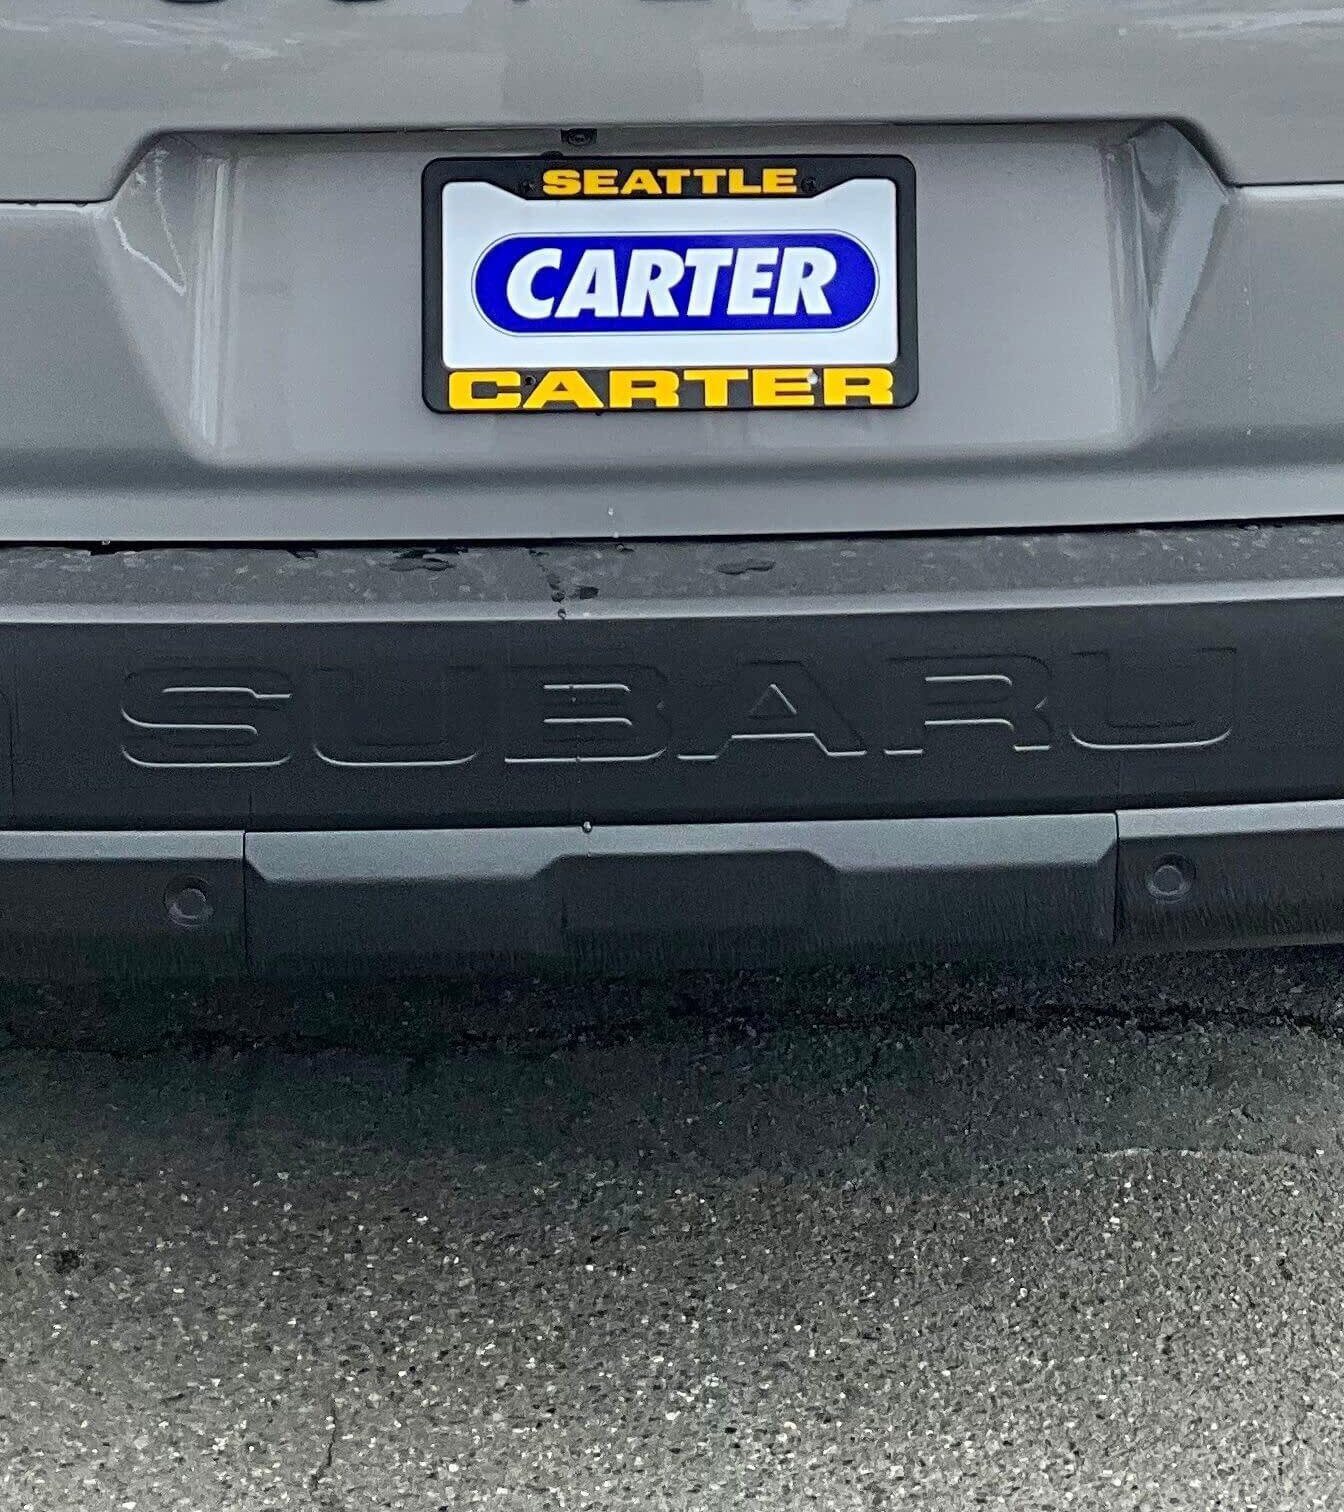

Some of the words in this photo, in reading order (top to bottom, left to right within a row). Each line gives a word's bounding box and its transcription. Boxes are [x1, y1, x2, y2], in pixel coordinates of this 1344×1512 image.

[542, 168, 798, 196] SEATTLE
[505, 246, 838, 320] CARTER
[448, 368, 895, 411] CARTER
[120, 645, 1239, 770] SUBARU
